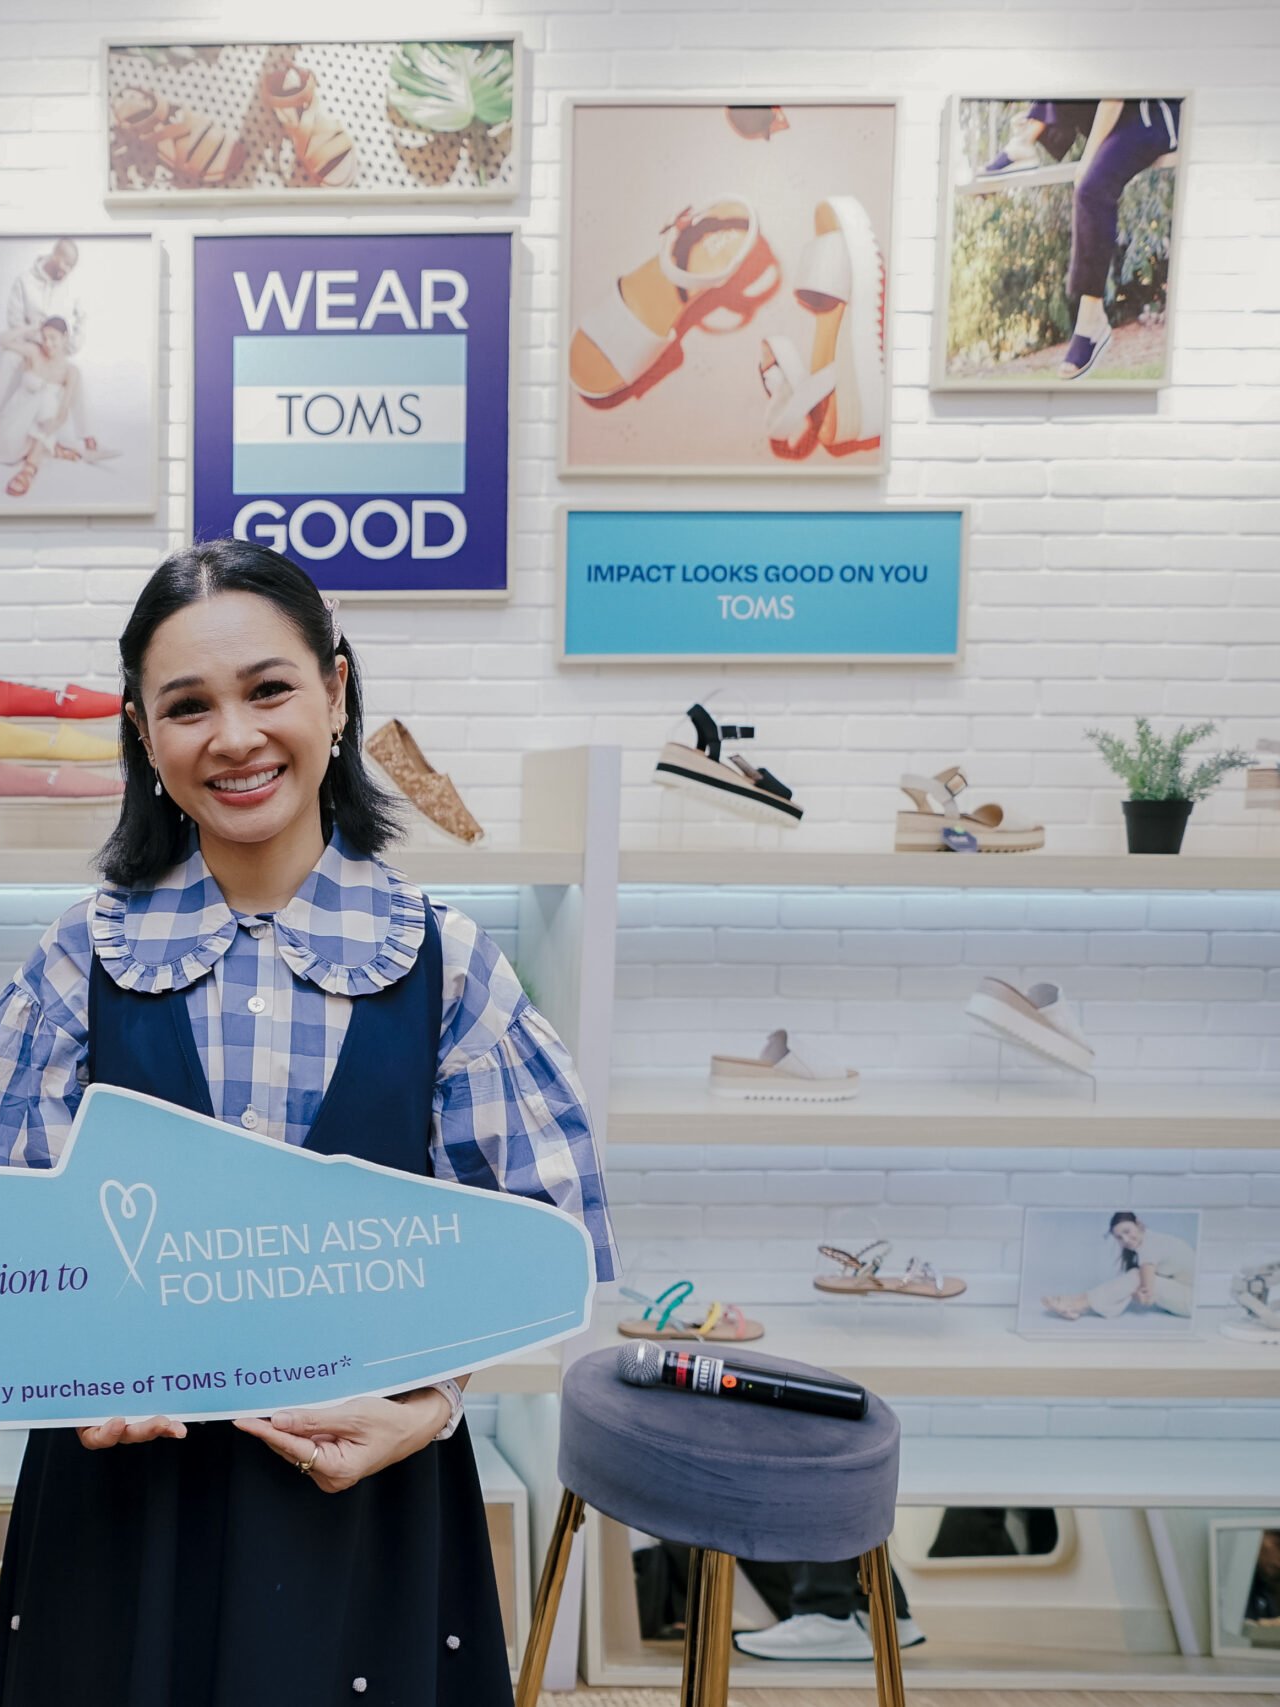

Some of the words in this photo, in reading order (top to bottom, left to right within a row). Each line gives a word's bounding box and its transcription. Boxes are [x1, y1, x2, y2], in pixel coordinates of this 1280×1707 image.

[233, 269, 469, 331] WEAR
[276, 393, 422, 436] TOMS
[233, 499, 468, 560] GOOD
[587, 565, 676, 583] IMPACT
[682, 565, 758, 583] LOOKS
[764, 565, 834, 583] GOOD
[839, 565, 874, 583] ON
[880, 565, 929, 583] YOU
[718, 595, 795, 620] TOMS
[156, 1224, 310, 1263] ANDIEN
[320, 1213, 461, 1253] AISYAH
[57, 1263, 88, 1291] to
[160, 1258, 425, 1306] FOUNDATION
[22, 1379, 125, 1402] purchase
[132, 1375, 155, 1394] of
[161, 1371, 227, 1391] TOMS
